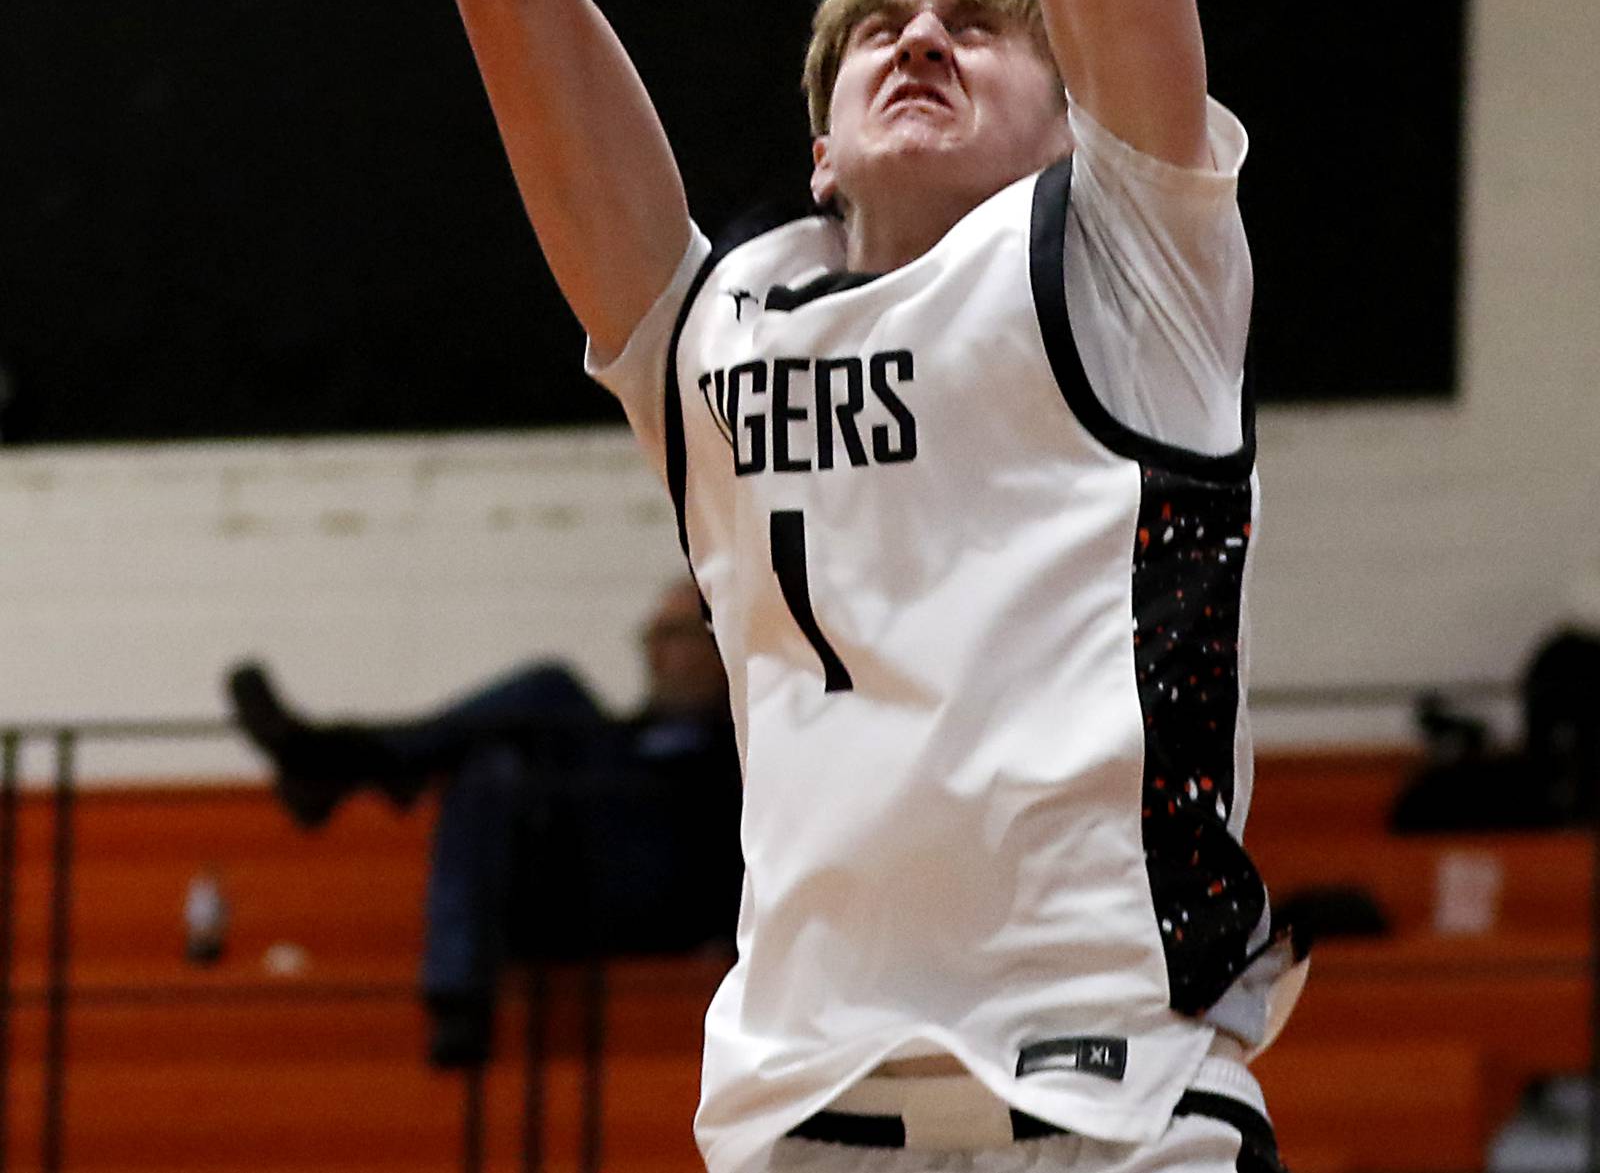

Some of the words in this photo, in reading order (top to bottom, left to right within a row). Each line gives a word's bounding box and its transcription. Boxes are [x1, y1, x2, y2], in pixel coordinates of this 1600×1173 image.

[699, 349, 918, 476] TIGERS
[769, 509, 854, 693] 1
[1089, 1045, 1115, 1066] XL
